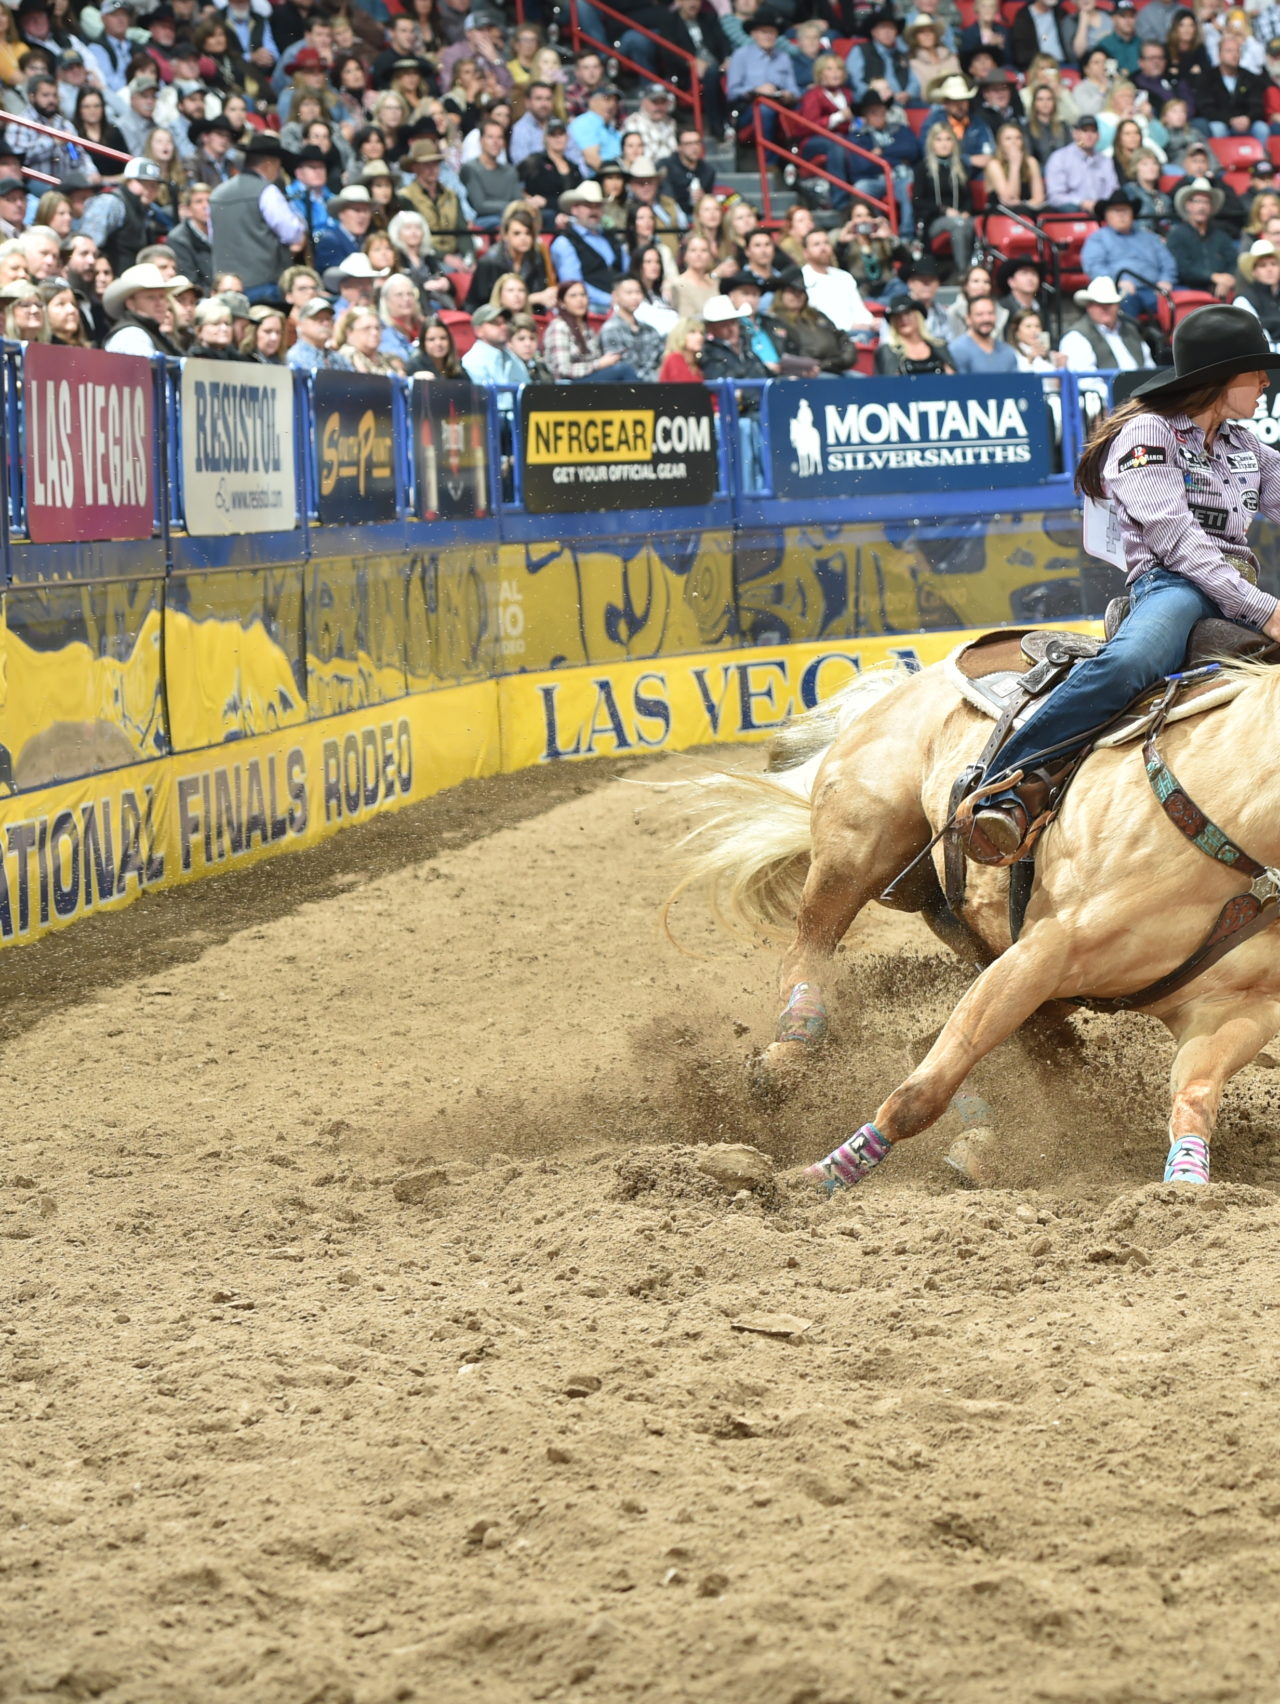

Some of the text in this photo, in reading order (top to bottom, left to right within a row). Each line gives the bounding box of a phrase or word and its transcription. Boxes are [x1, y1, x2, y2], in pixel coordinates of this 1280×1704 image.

[194, 380, 282, 474] RESISTOL
[825, 399, 1028, 446] MONTANA
[1253, 394, 1269, 419] E
[31, 380, 148, 509] LAS VEGAS
[534, 416, 711, 455] NFRGEAR.COM
[827, 444, 1031, 473] SILVERSMITHS
[552, 462, 687, 484] GET YOUR OFFICIAL GEAR
[538, 648, 923, 759] LAS VEG
[177, 748, 308, 873] FINALS
[323, 717, 412, 823] RODEO
